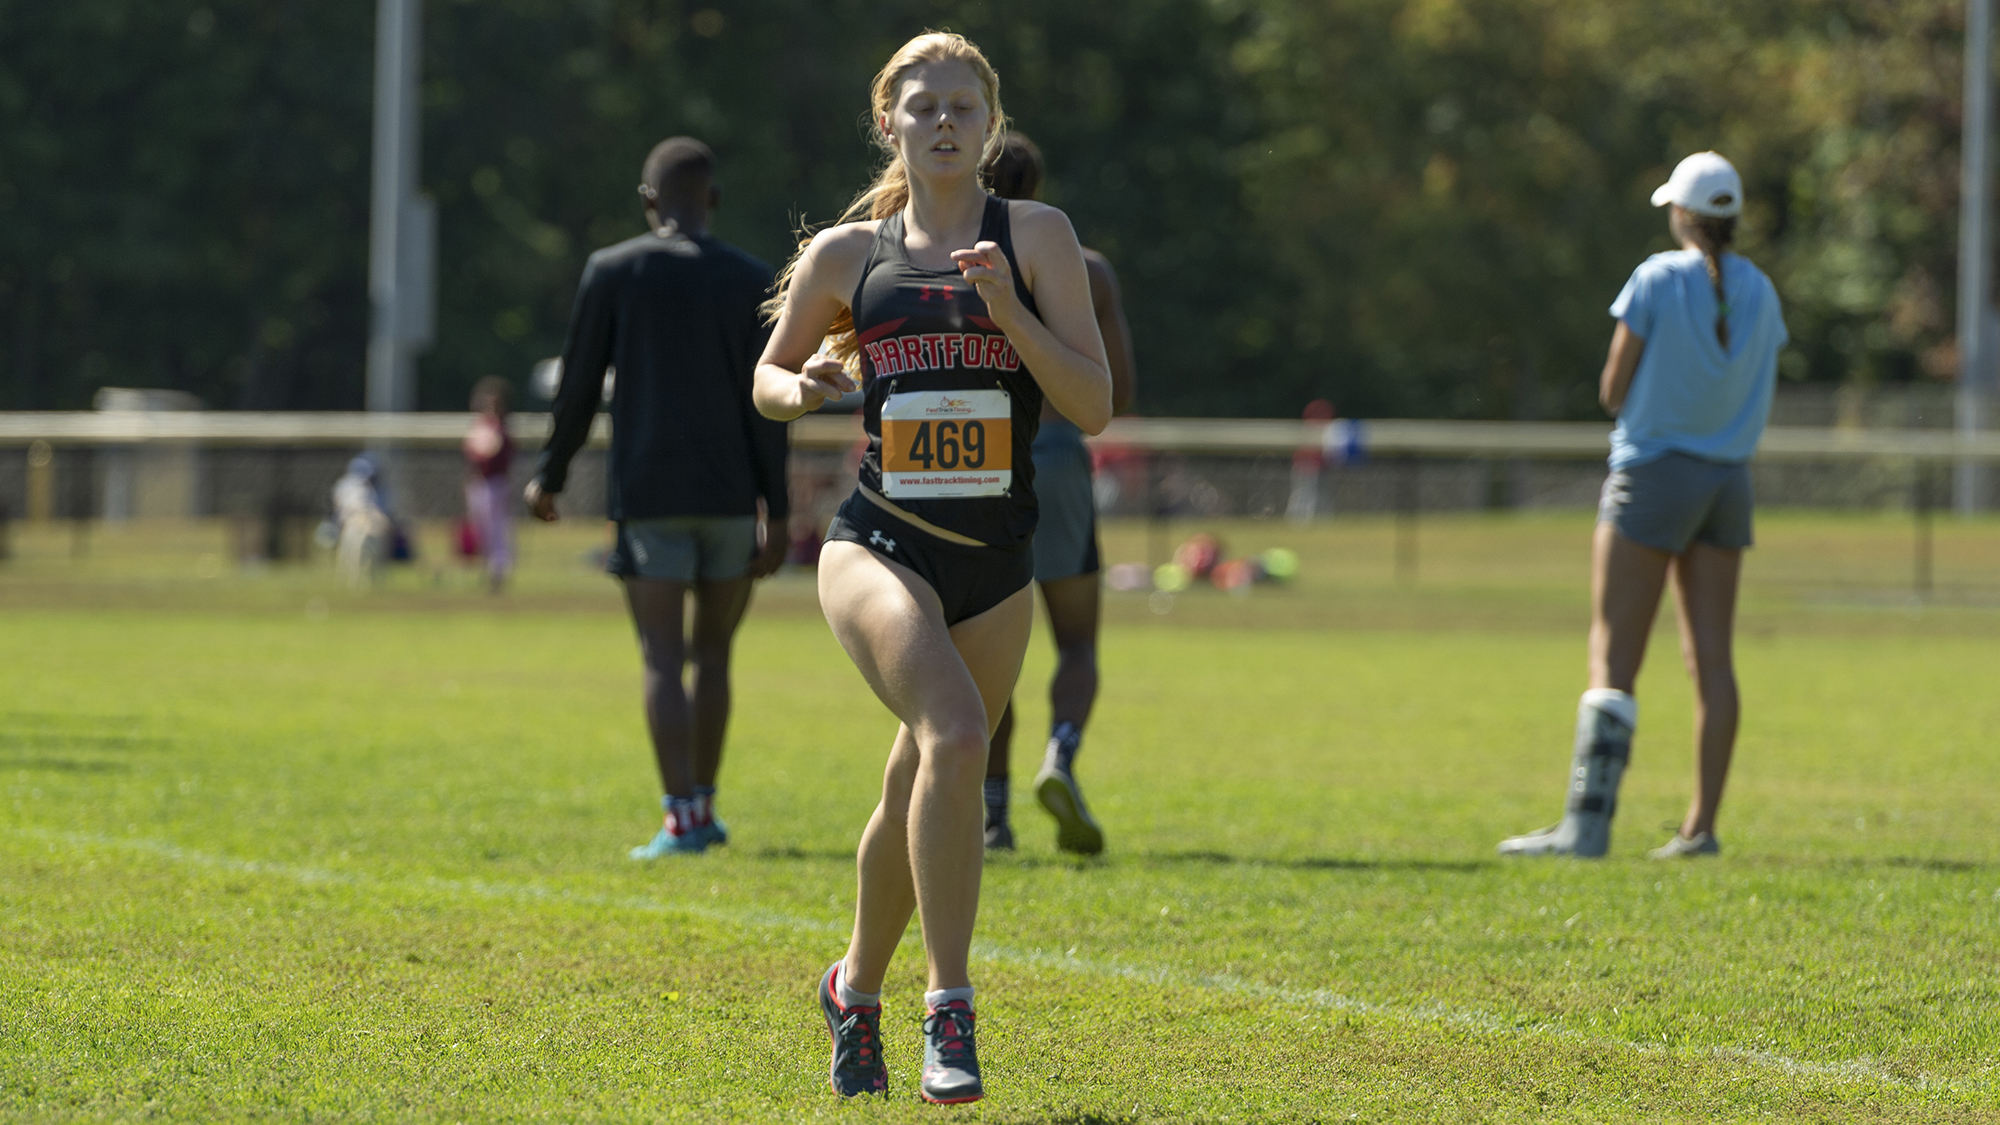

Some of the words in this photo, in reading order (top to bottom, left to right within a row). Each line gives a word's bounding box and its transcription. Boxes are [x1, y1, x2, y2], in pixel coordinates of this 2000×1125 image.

[865, 333, 1021, 378] HARTFORD
[909, 420, 985, 469] 469
[899, 475, 1000, 485] www.fasttracktiming.com
